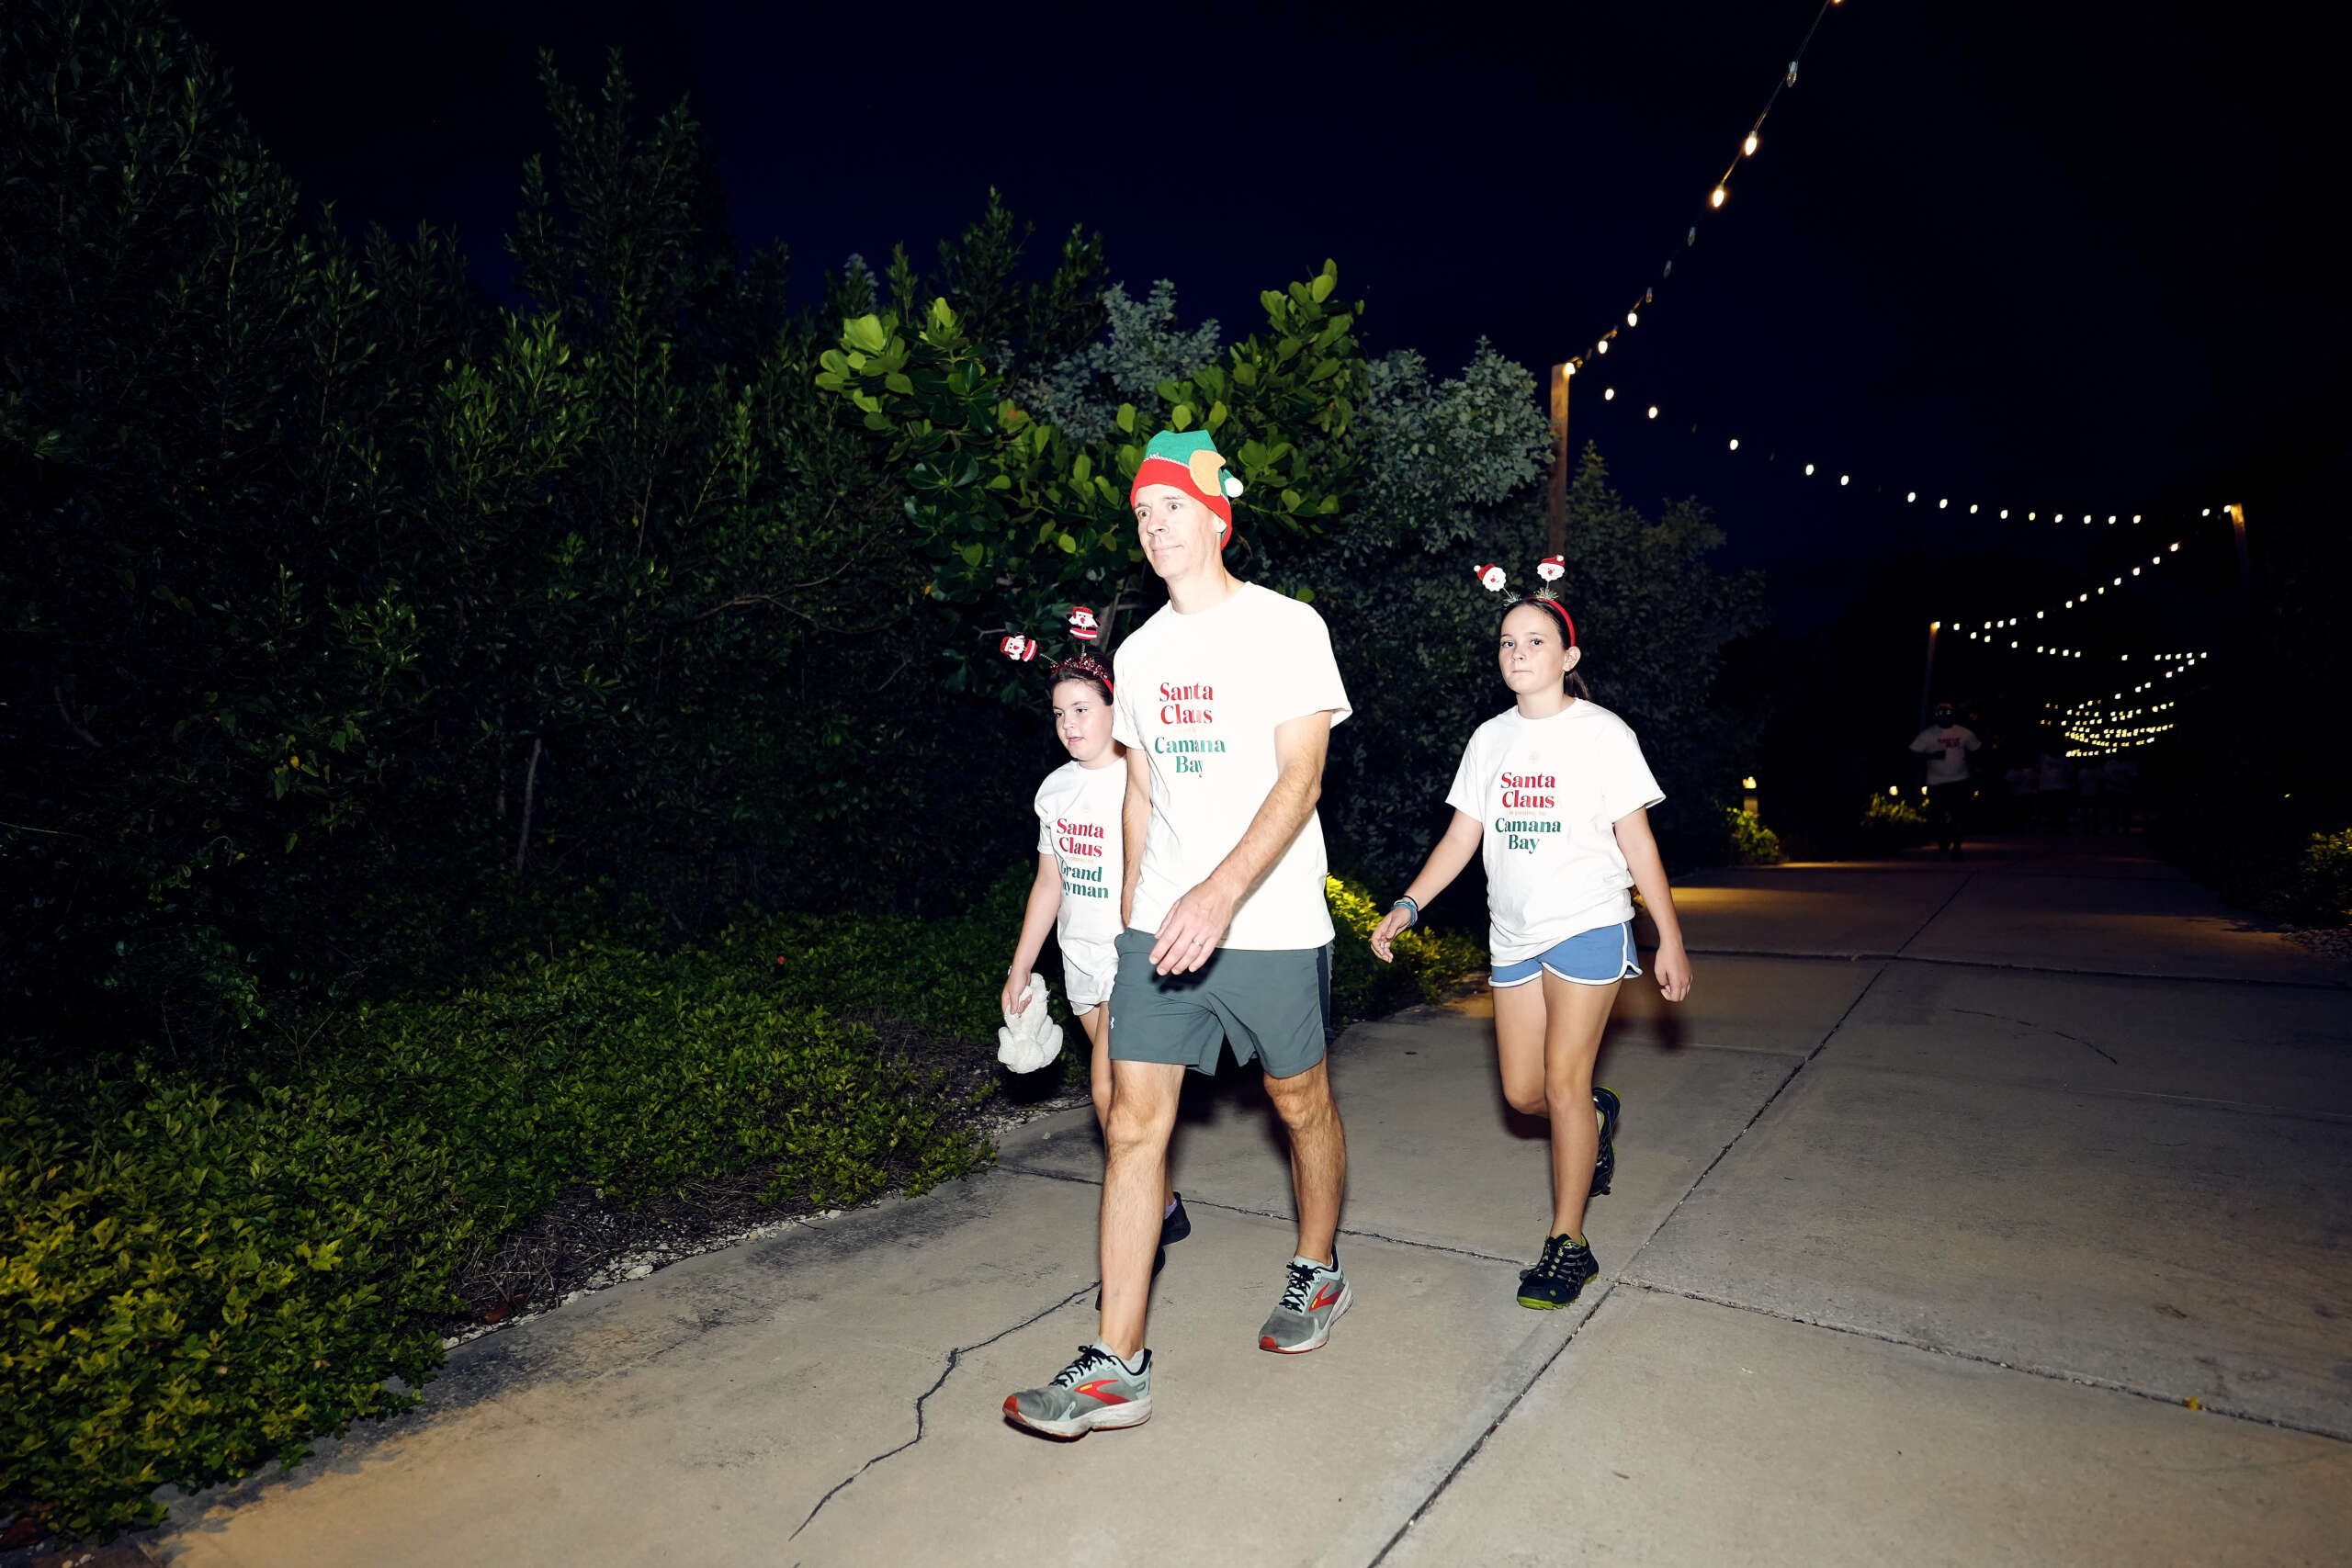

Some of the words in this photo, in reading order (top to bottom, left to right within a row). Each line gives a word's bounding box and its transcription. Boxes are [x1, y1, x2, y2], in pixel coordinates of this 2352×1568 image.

[1159, 682, 1214, 703] Santa
[1175, 755, 1204, 778] Bay
[1500, 772, 1555, 789] Santa
[1502, 790, 1555, 808] Claus
[1057, 818, 1104, 839] Santa
[1495, 818, 1562, 833] Camana
[1059, 837, 1102, 857] Claus
[1508, 834, 1541, 854] Bay
